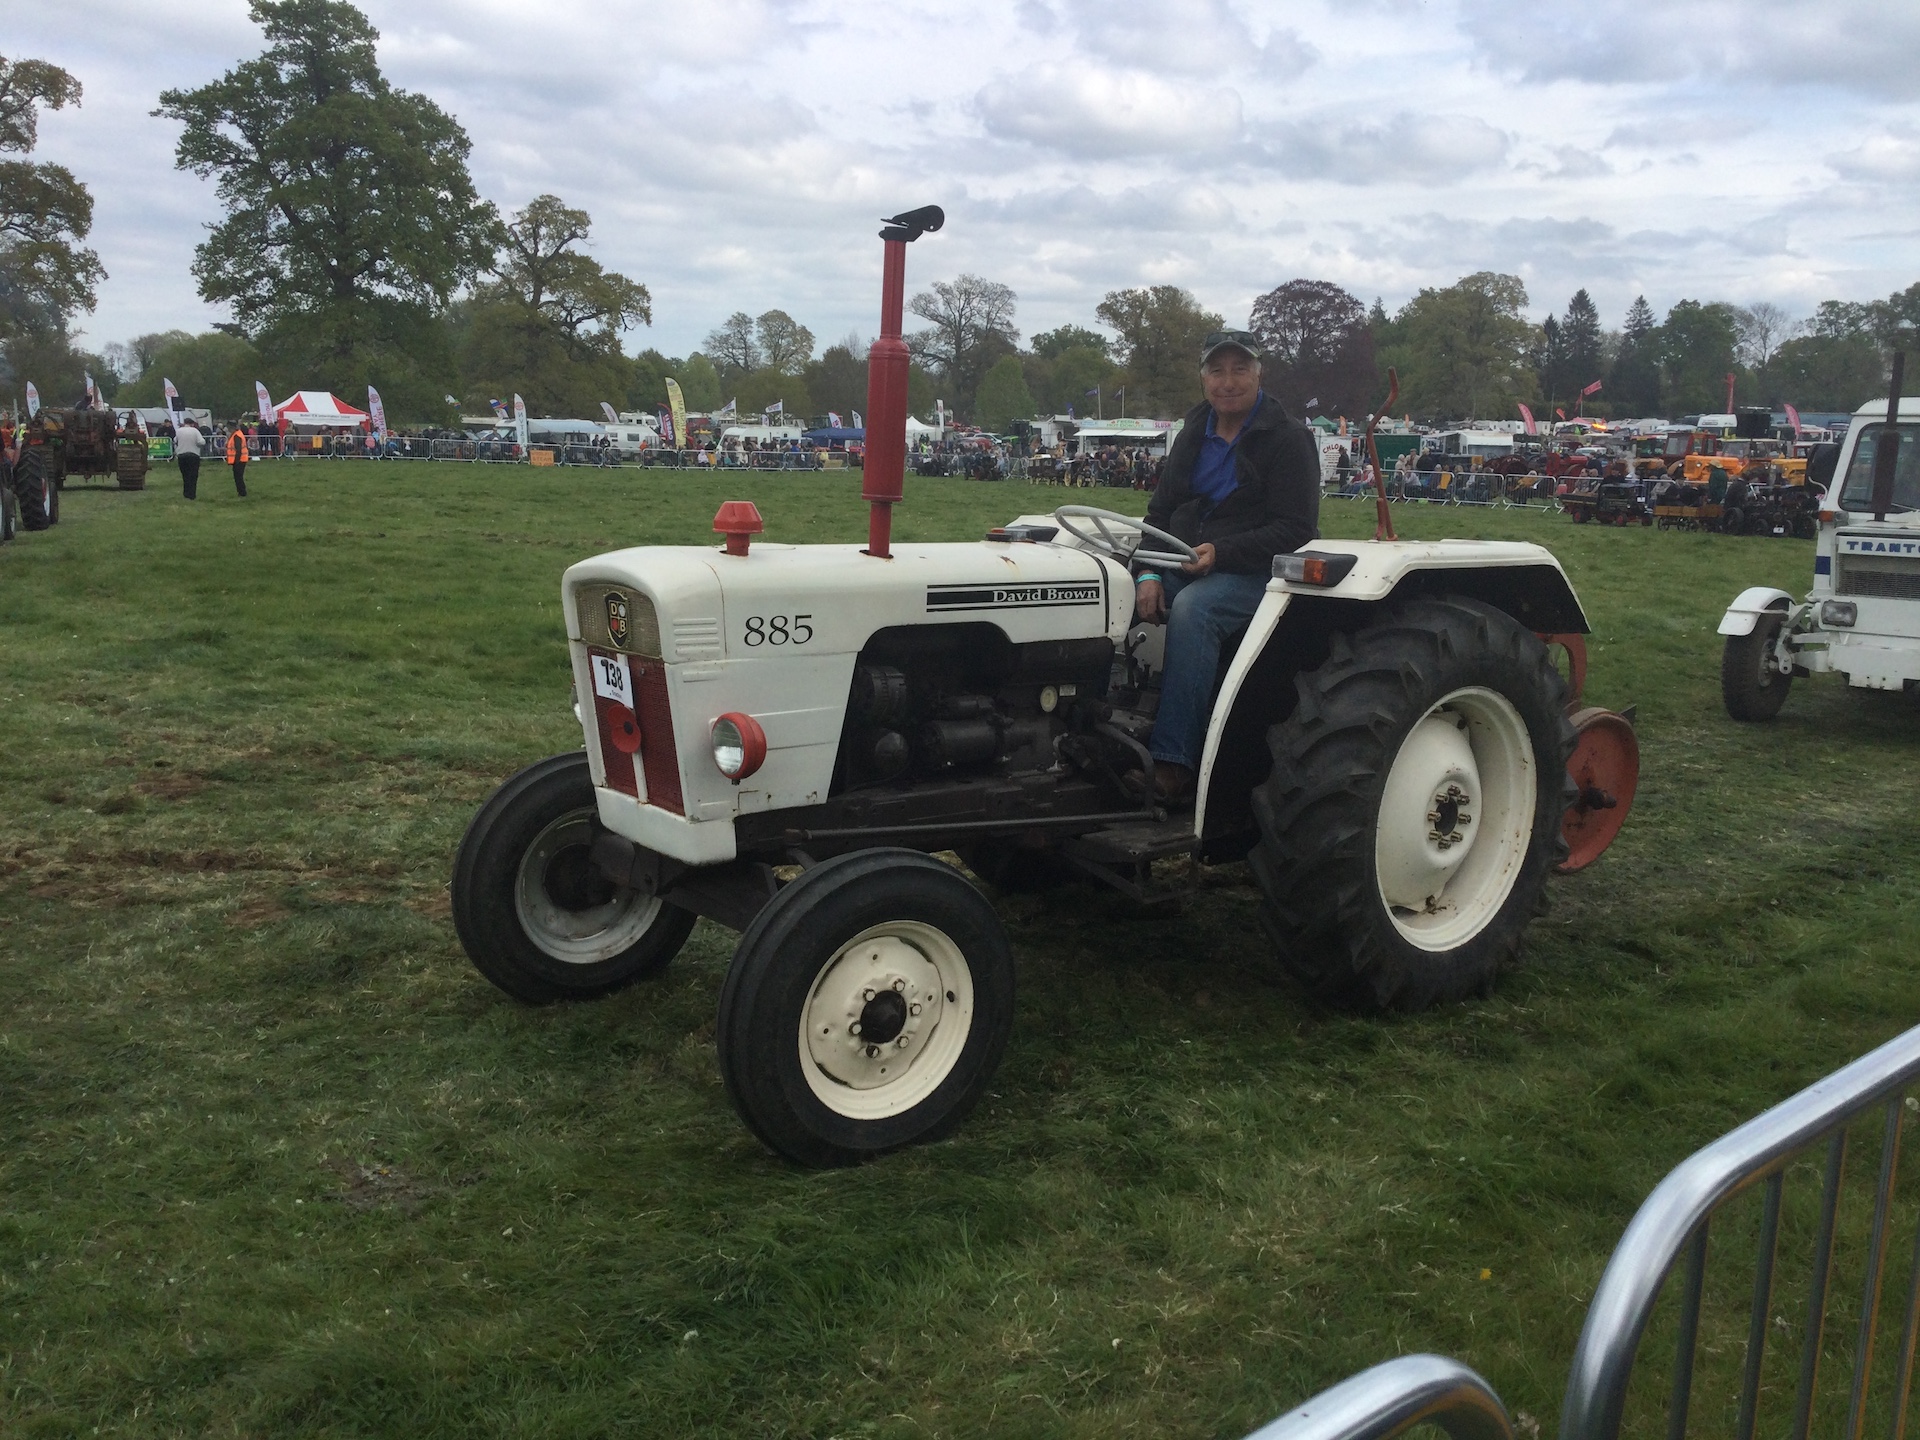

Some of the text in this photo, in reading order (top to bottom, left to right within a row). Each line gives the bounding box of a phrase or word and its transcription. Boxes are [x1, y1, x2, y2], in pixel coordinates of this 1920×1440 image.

[1846, 541, 1920, 553] TRANT
[993, 588, 1097, 602] David Brown
[744, 614, 814, 647] 885
